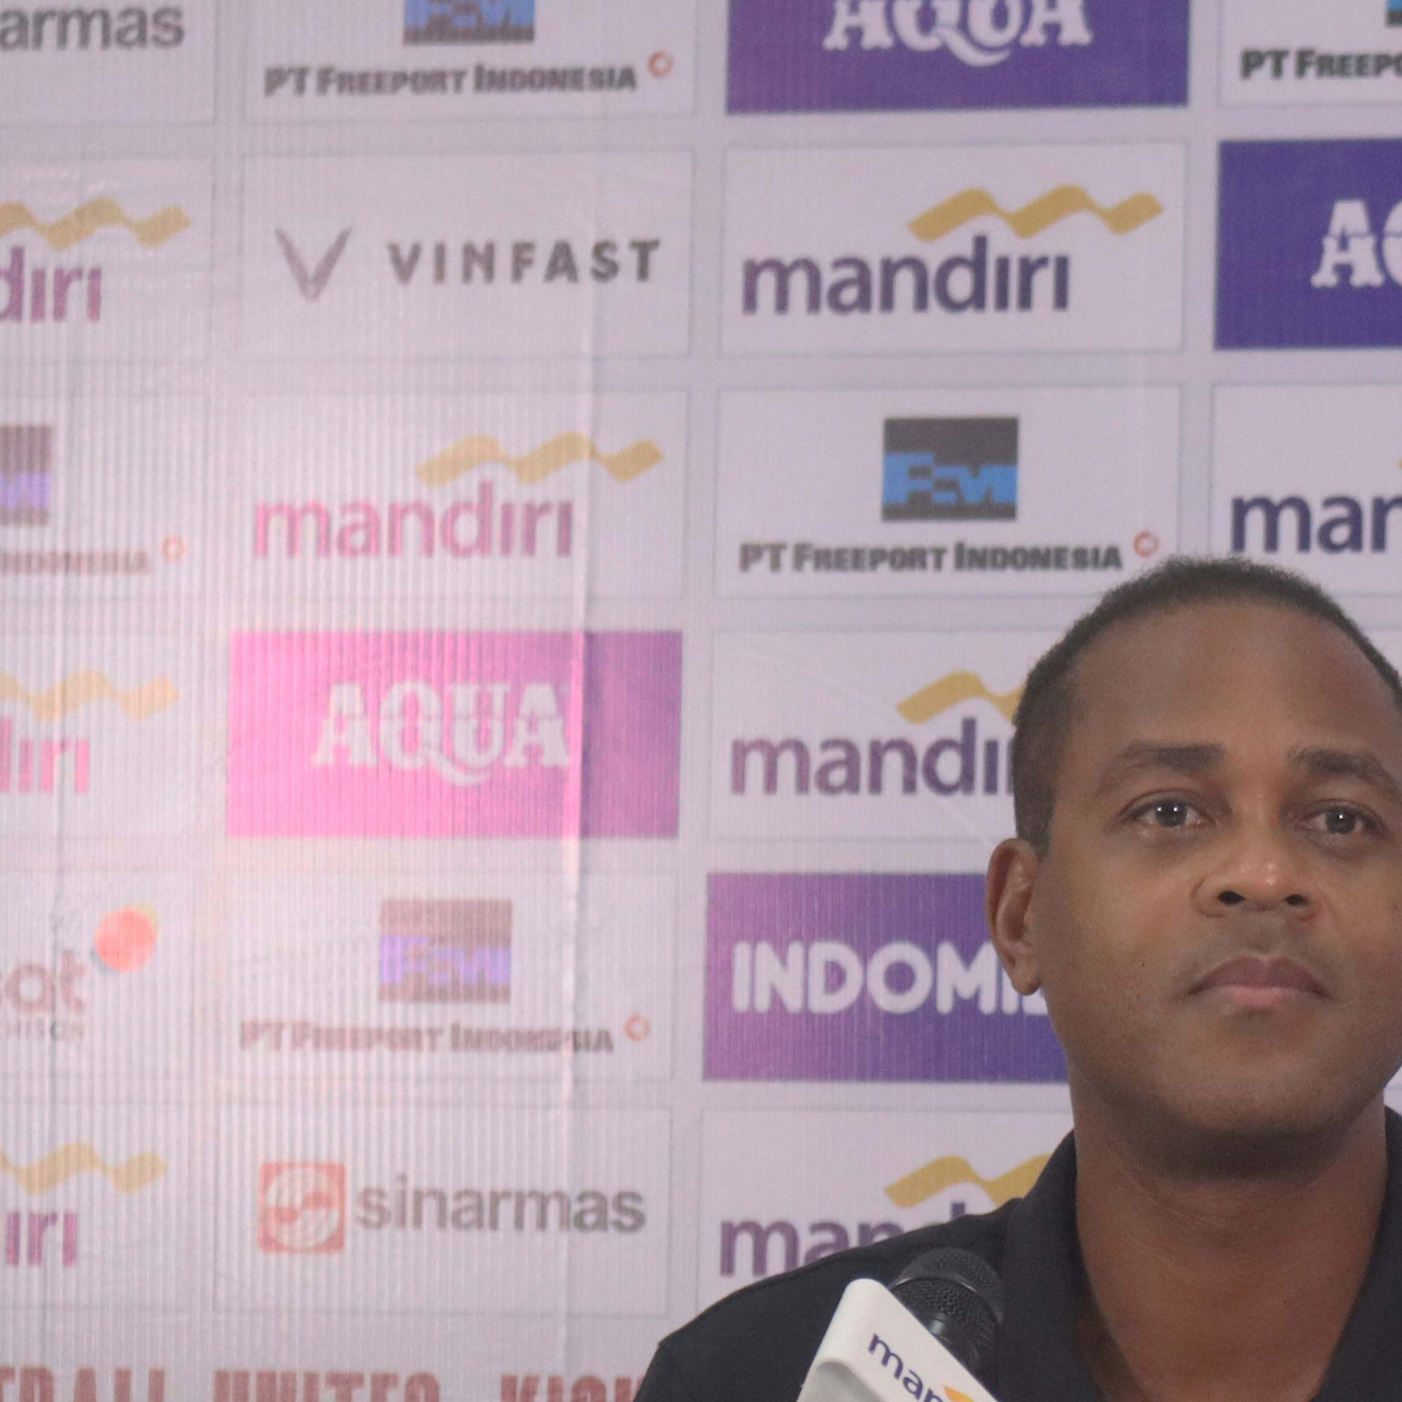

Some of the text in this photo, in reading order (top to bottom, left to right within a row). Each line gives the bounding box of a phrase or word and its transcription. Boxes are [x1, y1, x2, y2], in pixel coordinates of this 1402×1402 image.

[264, 63, 638, 96] PT FREEPORT INDONESIA
[1240, 49, 1290, 79] PT
[389, 238, 661, 283] VINFAST
[743, 234, 1070, 314] mandiri
[254, 481, 574, 558] mandiri
[739, 541, 1123, 572] PT FREEPORT INDONESIA
[311, 682, 570, 786] AQUA
[730, 718, 1013, 796] mandi
[731, 939, 1046, 1014] INDOM
[357, 1173, 646, 1233] sinarmas
